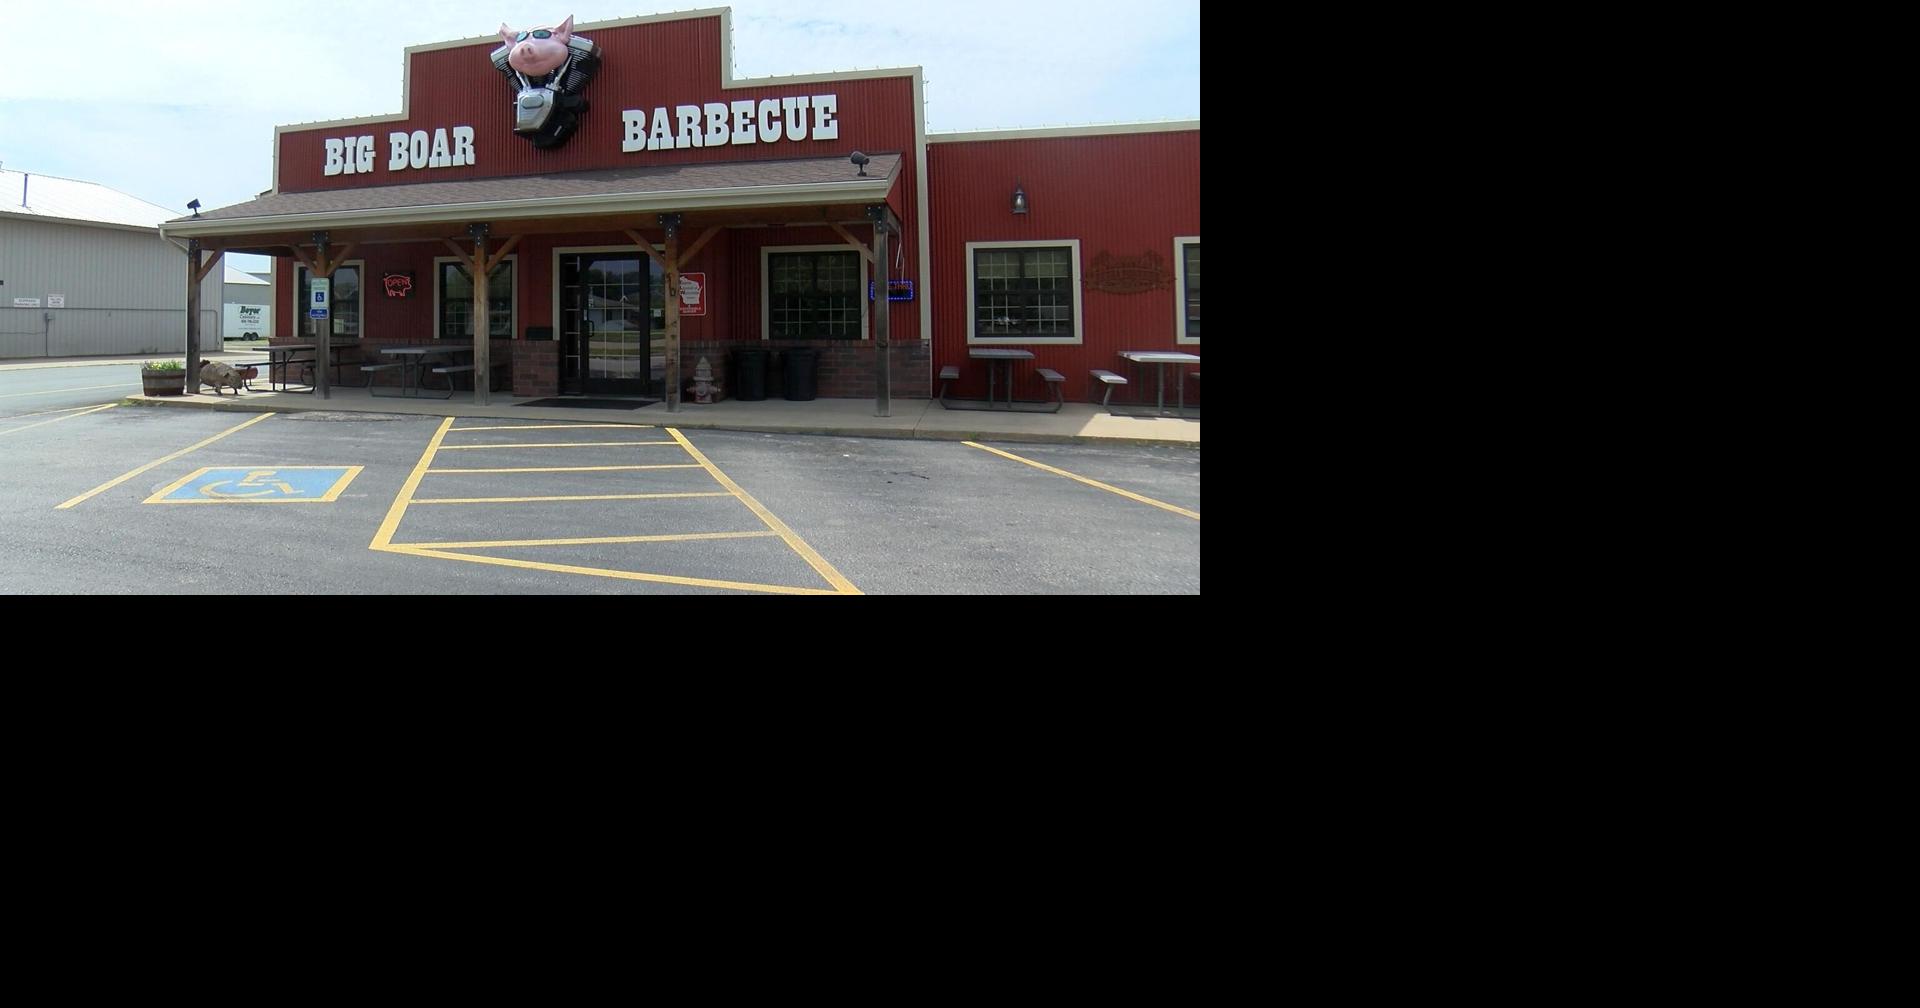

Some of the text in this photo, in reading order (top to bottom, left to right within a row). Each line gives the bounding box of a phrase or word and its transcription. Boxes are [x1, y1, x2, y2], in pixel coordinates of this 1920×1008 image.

[622, 94, 838, 153] BARBECUE
[324, 126, 475, 176] BIG BOAR
[388, 279, 407, 287] OPEN
